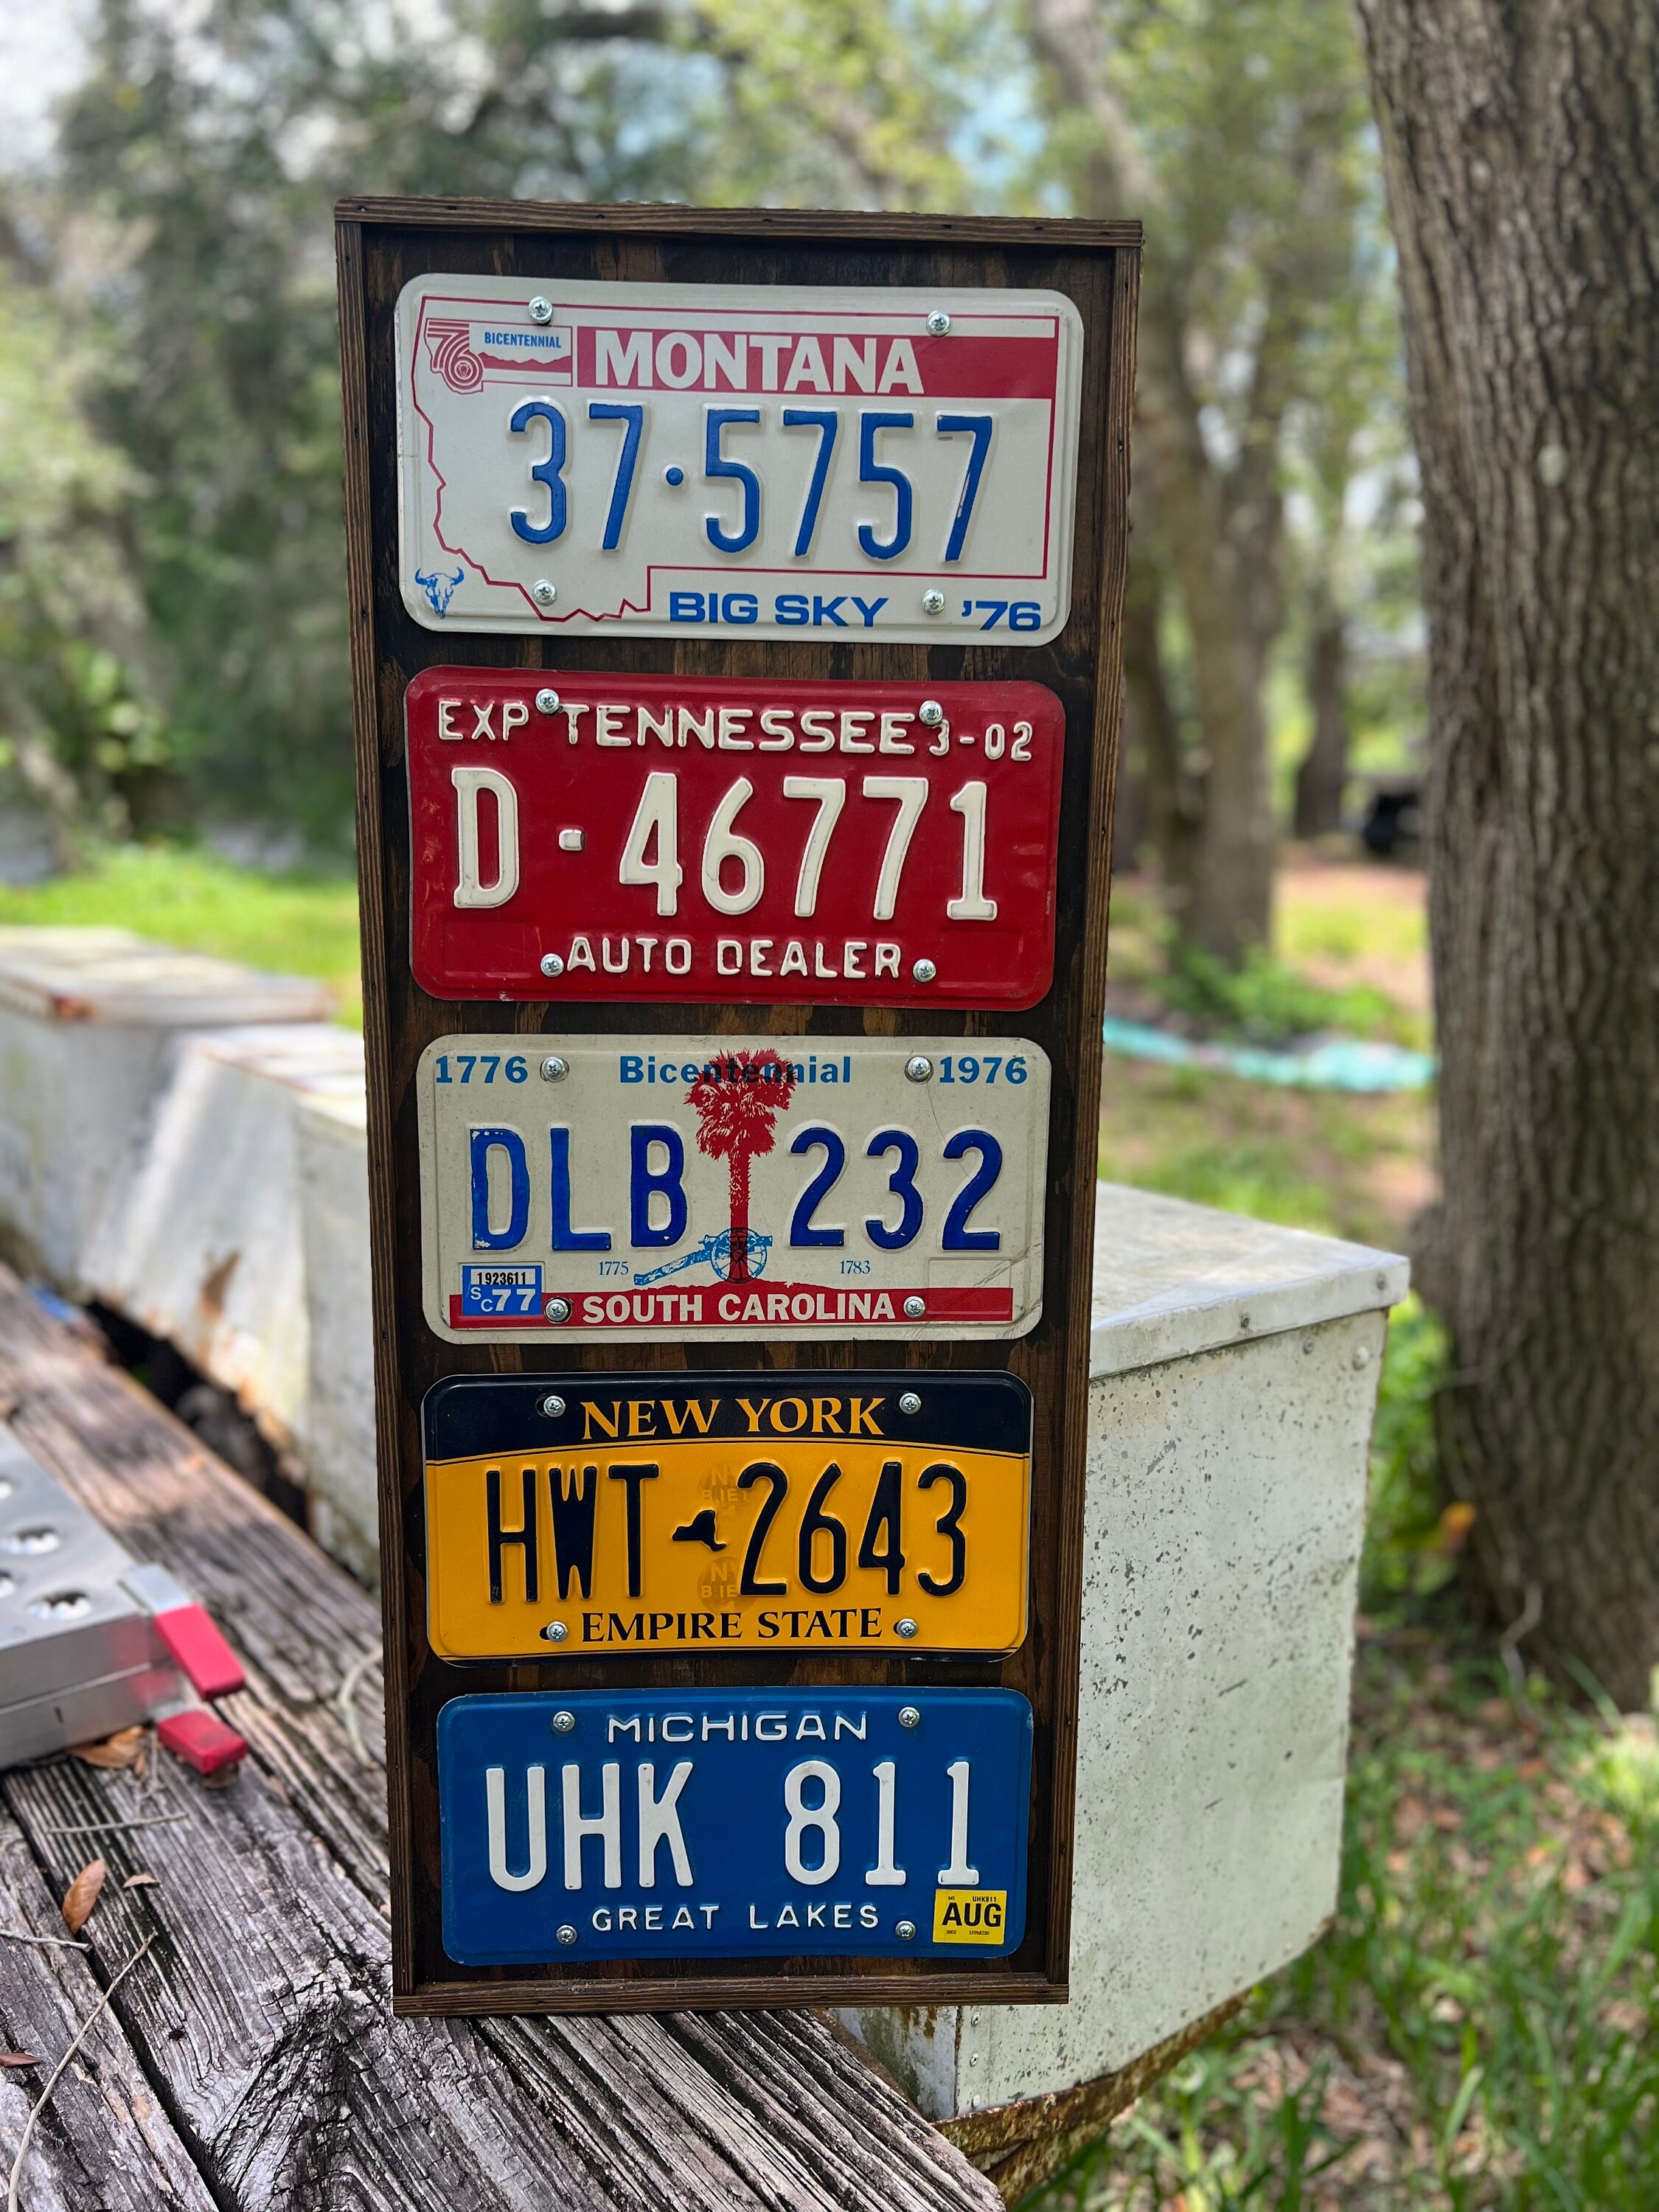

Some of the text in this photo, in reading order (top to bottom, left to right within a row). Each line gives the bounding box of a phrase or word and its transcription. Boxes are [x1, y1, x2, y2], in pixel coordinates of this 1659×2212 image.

[484, 332, 562, 349] BICENTENNIAL
[595, 329, 925, 394] MONTANA
[669, 592, 759, 625] BIG
[775, 594, 888, 627] SKY
[438, 701, 1033, 762] EXP TENNESSEE 3-02
[566, 936, 902, 978] AUTO DEALER
[436, 1055, 1028, 1085] 1776 Bicentennial 1976
[470, 1125, 1003, 1251] DLB 232
[477, 1272, 526, 1285] 1923611
[599, 1262, 629, 1276] 1775
[839, 1260, 871, 1275] 1783
[582, 1293, 896, 1323] SOUTH CAROLINA
[580, 1397, 887, 1440] NEW YORK
[485, 1461, 967, 1604] HWT 2643
[581, 1607, 883, 1643] EMPIRE STATE
[608, 1712, 866, 1743] MICHIGAN
[486, 1759, 980, 1892] UHK 811
[592, 1904, 879, 1932] GREAT LAKES
[942, 1902, 1002, 1927] AUG
